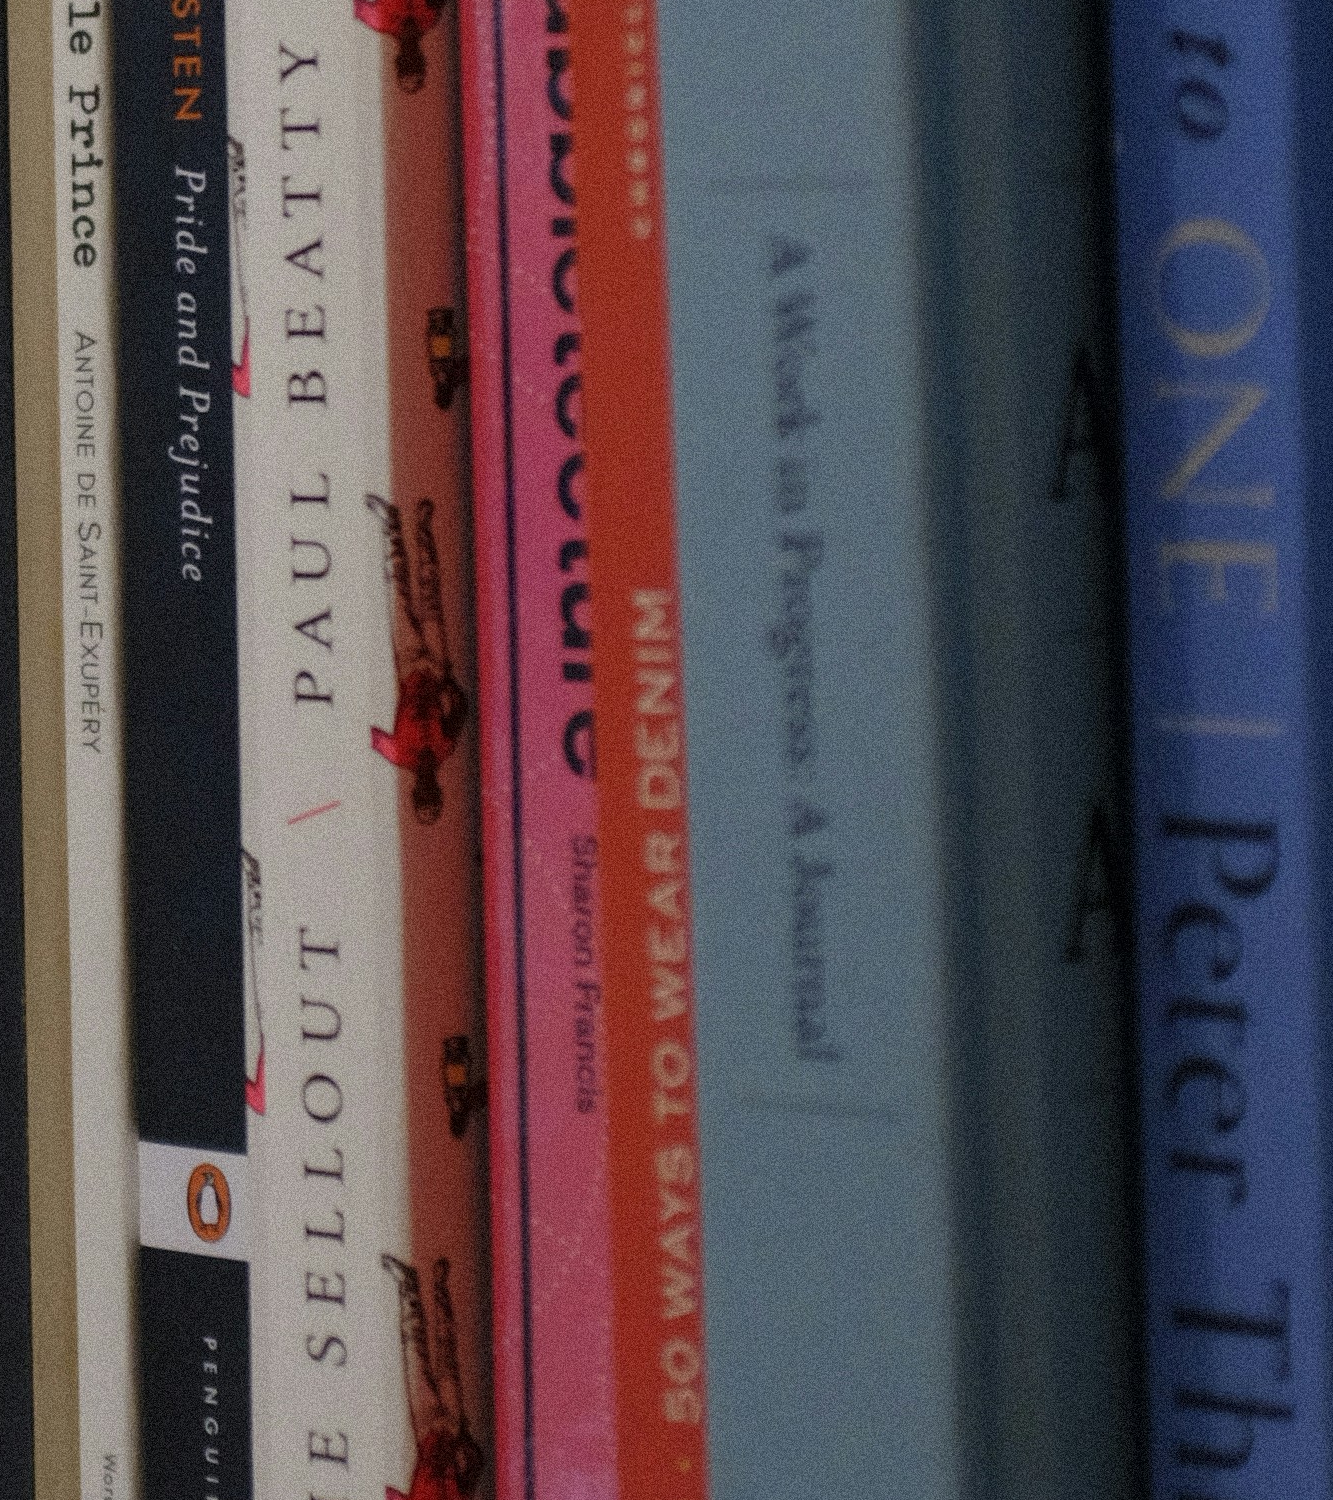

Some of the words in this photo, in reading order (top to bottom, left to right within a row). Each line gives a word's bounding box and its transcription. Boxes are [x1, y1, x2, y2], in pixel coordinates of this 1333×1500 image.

[1168, 27, 1238, 144] to
[67, 85, 104, 270] Prince
[174, 164, 209, 275] Pride
[279, 41, 329, 409] BEATTY
[769, 235, 815, 276] A
[176, 291, 211, 370] and
[773, 292, 821, 440] Work
[167, 386, 213, 582] Prejudice
[777, 456, 817, 515] in
[1151, 218, 1278, 622] ONE
[289, 471, 336, 709] PAUL
[631, 588, 681, 810] DENIM
[786, 797, 829, 838] A
[572, 834, 599, 967] Sharon
[643, 831, 688, 1022] WEAR
[789, 853, 843, 1062] Journal
[575, 979, 603, 1115] Francis
[652, 1041, 691, 1125] TO
[1159, 812, 1283, 1210] Peter
[298, 926, 348, 1368] SELLOUT
[653, 1143, 701, 1322] WAYS
[661, 1336, 702, 1426] 50
